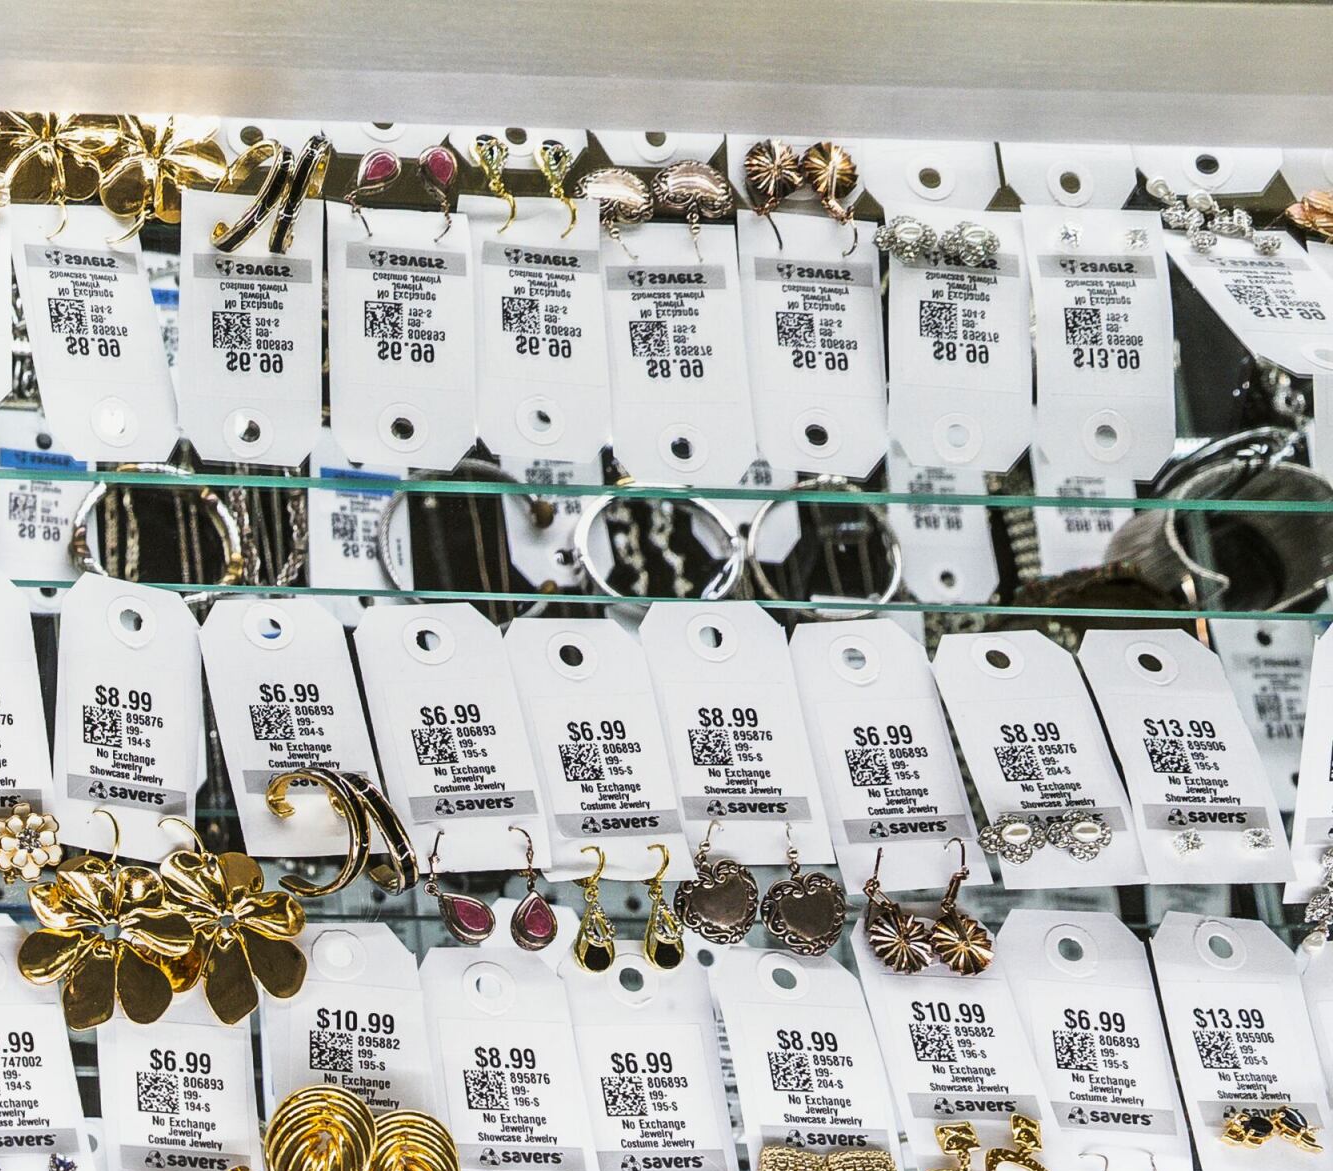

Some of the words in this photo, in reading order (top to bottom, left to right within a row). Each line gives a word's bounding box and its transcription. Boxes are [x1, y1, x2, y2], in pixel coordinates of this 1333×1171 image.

[94, 684, 152, 715] $8.99
[259, 682, 319, 707] $6.99
[125, 712, 163, 728] 895876
[419, 703, 480, 728] $6.99
[697, 707, 758, 731] $8.99
[455, 725, 496, 737] 806893
[566, 719, 626, 745] $6.99
[732, 730, 772, 741] 895876
[853, 724, 912, 747] $6.99
[1000, 721, 1060, 745] $8.99
[1143, 717, 1215, 740] $13.99
[1186, 740, 1226, 751] 895906
[108, 785, 166, 805] savers
[455, 796, 515, 811] savers
[727, 801, 788, 813] savers
[1187, 811, 1247, 824] savers
[316, 1007, 394, 1034] $10.99
[911, 1000, 985, 1026] $10.99
[1063, 1008, 1125, 1033] $6.99
[1192, 1007, 1264, 1029] $13.99
[357, 1035, 400, 1049] 895882
[776, 1028, 837, 1052] $8.99
[1098, 1034, 1139, 1048] 806893
[0, 1055, 42, 1067] 747002
[149, 1048, 211, 1074] $6.99
[474, 1046, 535, 1070] $8.99
[610, 1051, 672, 1076] $6.99
[646, 1076, 688, 1088] 806893
[806, 1132, 862, 1145] savers
[501, 1150, 563, 1164] savers
